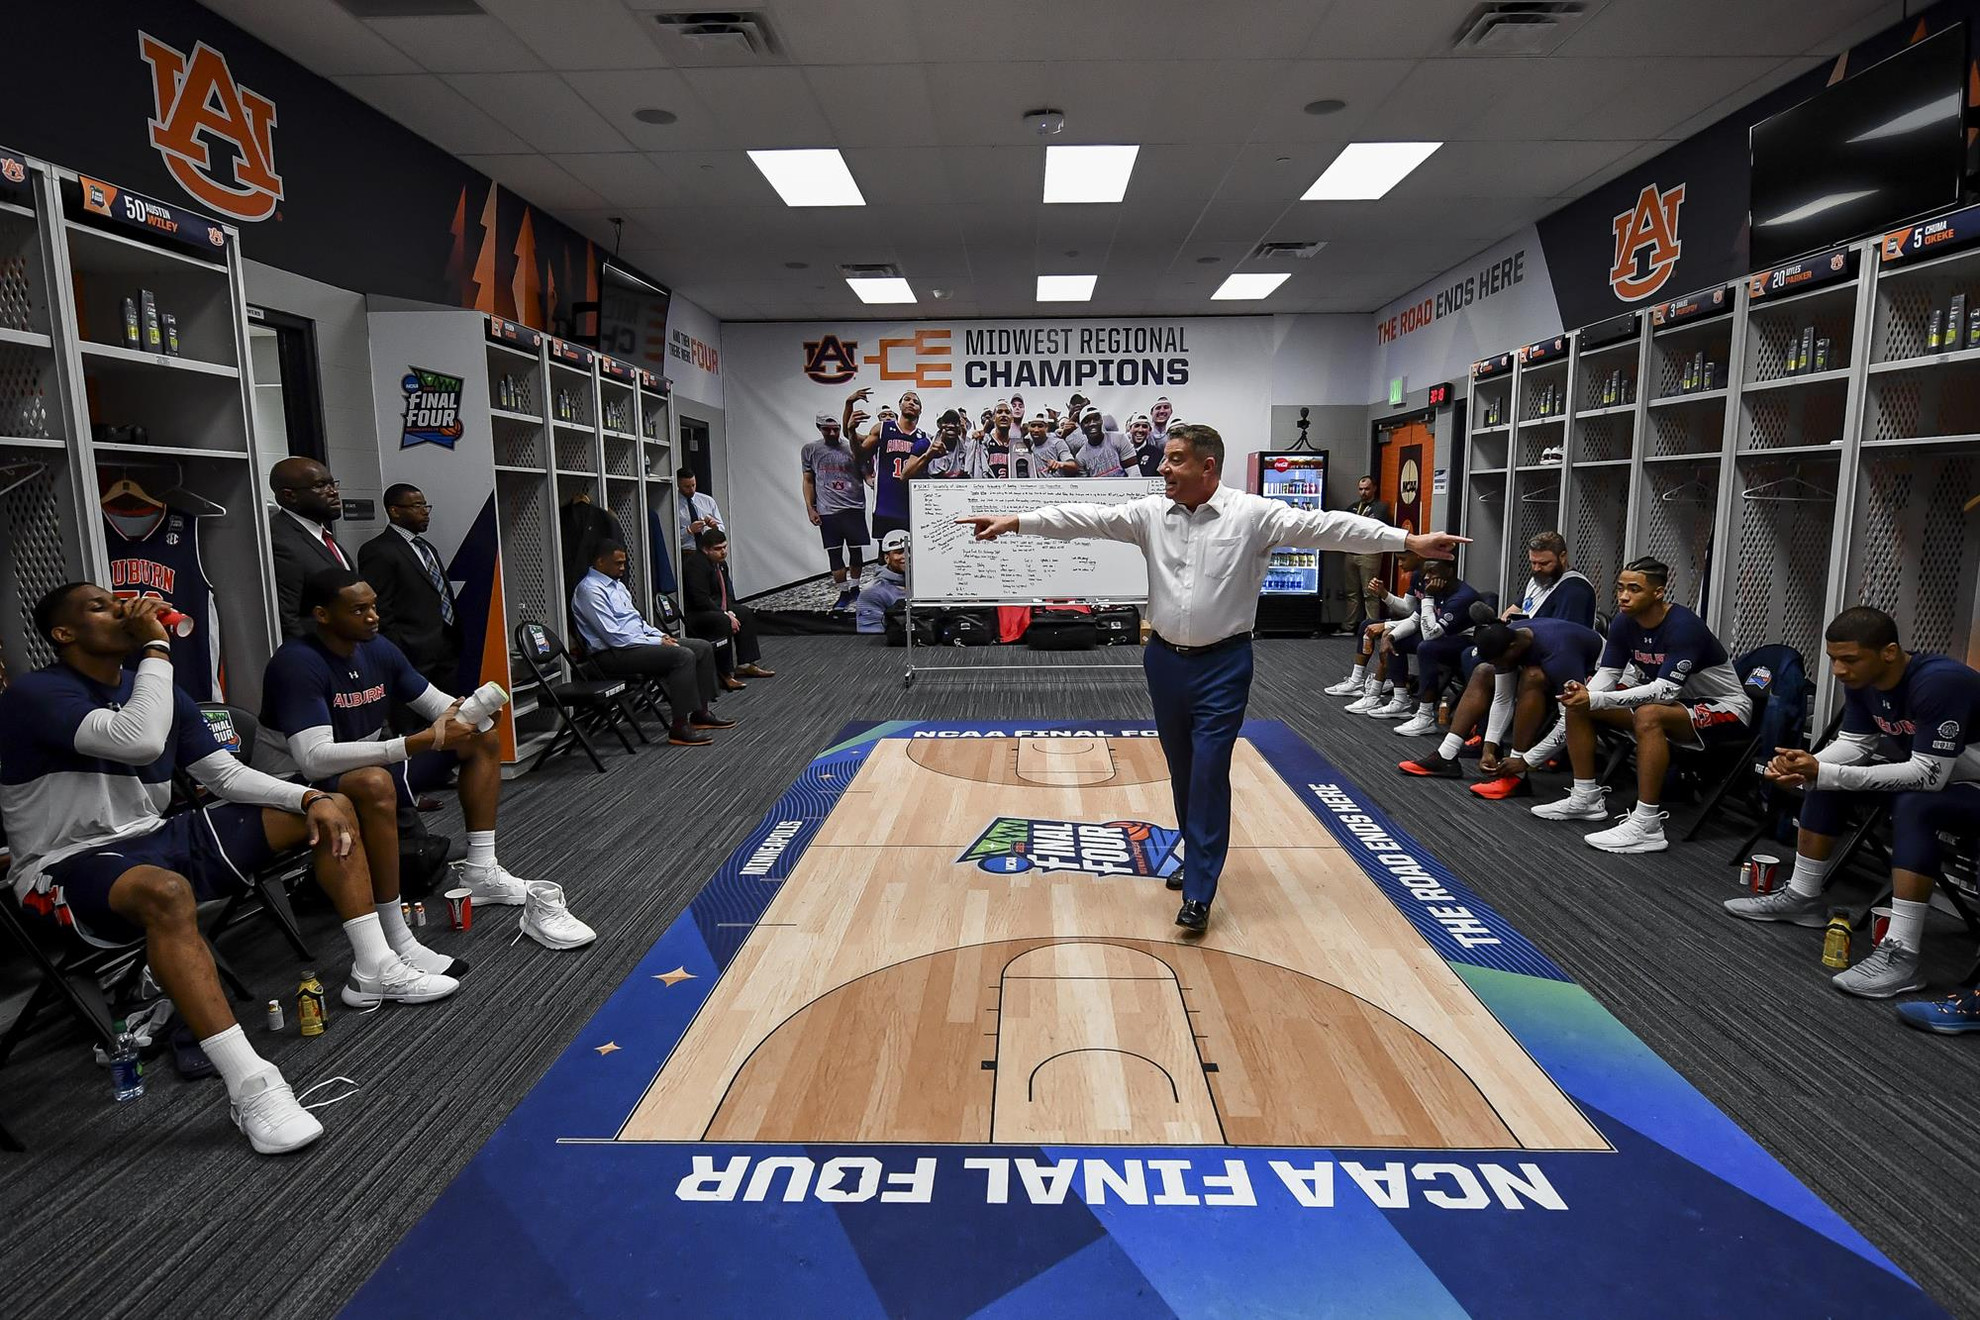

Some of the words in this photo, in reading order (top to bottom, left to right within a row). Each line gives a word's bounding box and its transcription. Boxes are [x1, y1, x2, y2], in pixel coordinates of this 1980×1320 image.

[123, 195, 147, 223] 50
[145, 202, 171, 221] AUSTIN
[147, 214, 179, 234] WILEY
[1913, 228, 1923, 248] 5
[1924, 220, 1948, 236] CHUMA
[1924, 228, 1955, 245] OKEKE
[1772, 271, 1786, 289] 20
[1785, 264, 1802, 277] MYLES
[1785, 270, 1813, 286] PARKER
[1377, 316, 1398, 346] THE
[1400, 298, 1434, 337] ROAD
[1435, 275, 1475, 320] ENDS
[1477, 249, 1525, 301] HERE
[1670, 303, 1676, 318] 3
[690, 336, 719, 375] FOUR
[965, 328, 1073, 356] MIDWEST
[1079, 326, 1190, 354] REGIONAL
[964, 357, 1190, 389] CHAMPIONS
[408, 391, 457, 410] FINAL
[406, 409, 456, 427] FOUR
[333, 683, 386, 709] AUBURN
[913, 730, 1008, 738] NCAA
[1014, 730, 1114, 738] FINAL
[1308, 783, 1363, 813] HERE
[1027, 824, 1081, 870] FINAL
[1338, 814, 1403, 851] ENDS
[739, 820, 803, 875] MINNEAPOLIS
[1079, 825, 1134, 874] FOUR
[1377, 854, 1456, 901] ROAD
[1427, 906, 1502, 949] THE
[675, 1155, 937, 1203] FOUR
[964, 1158, 1258, 1206] FINAL
[1268, 1160, 1569, 1210] NCAA
